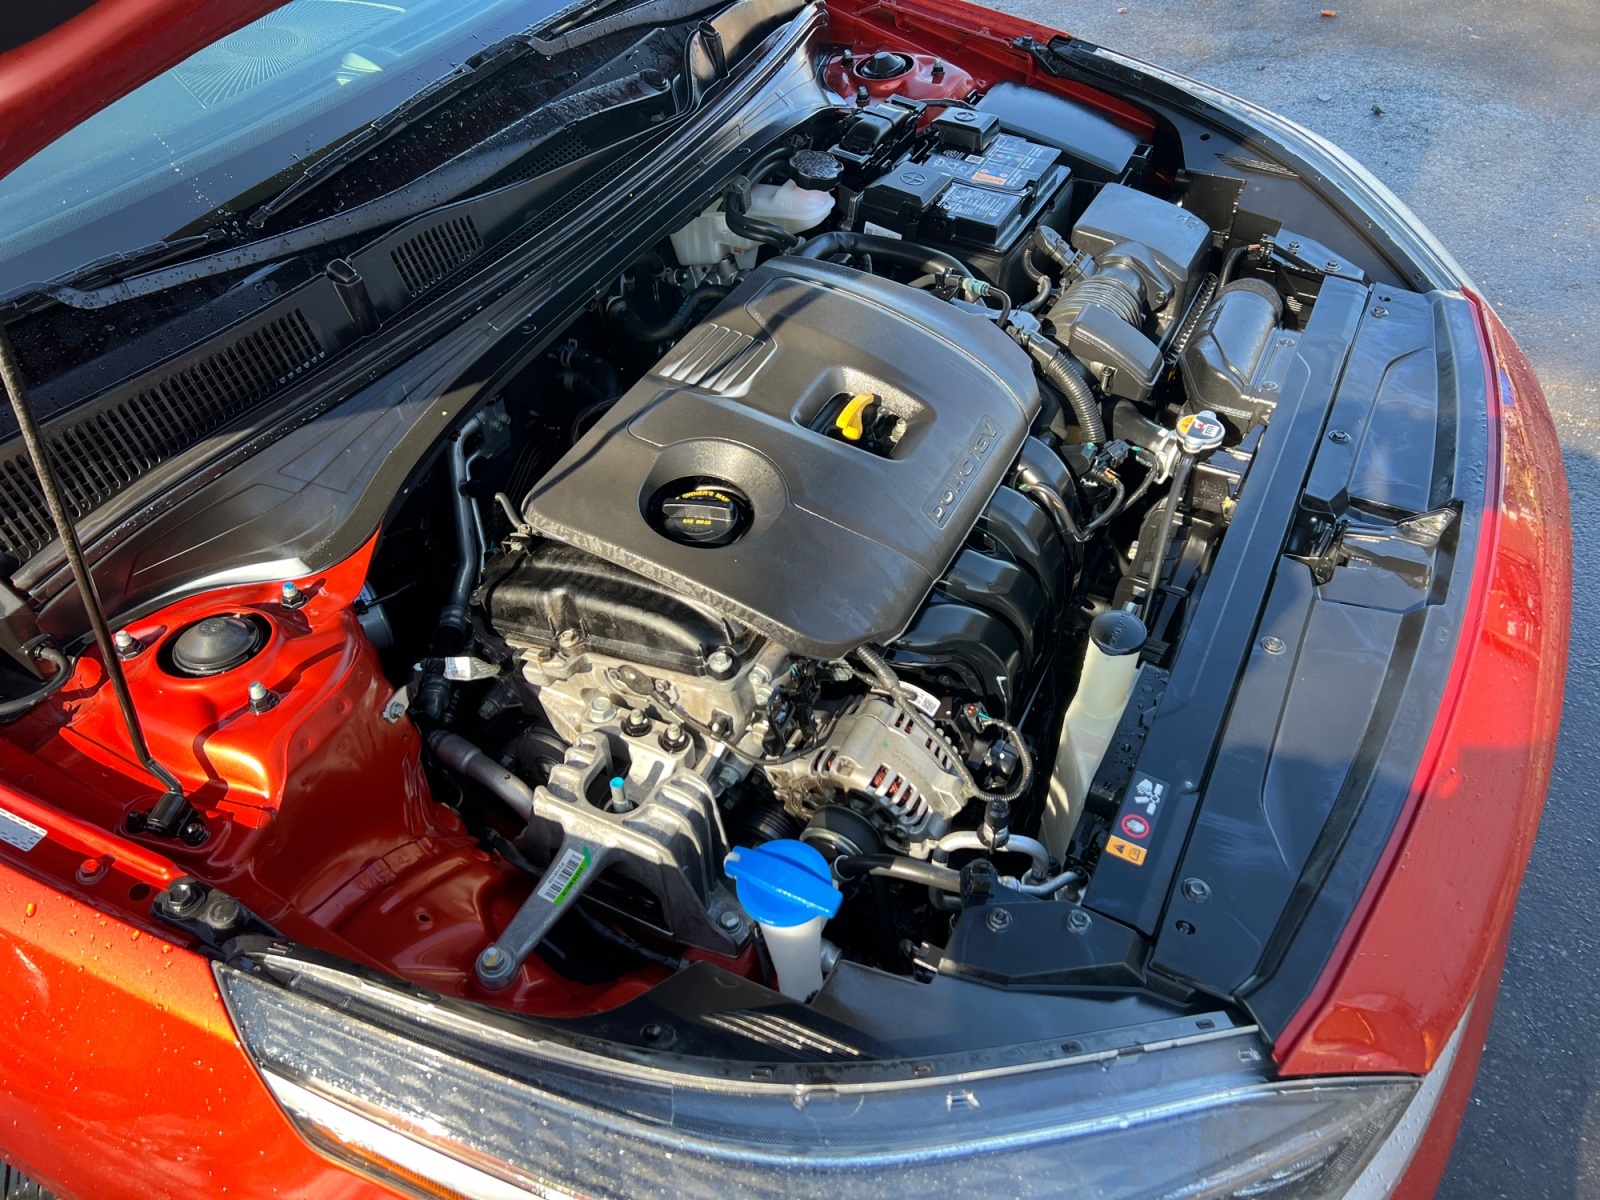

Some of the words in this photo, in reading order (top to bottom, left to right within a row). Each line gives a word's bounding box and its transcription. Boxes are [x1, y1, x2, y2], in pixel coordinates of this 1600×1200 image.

[682, 490, 714, 498] OWNER'S
[928, 459, 975, 525] DOHC
[968, 422, 998, 461] 16V
